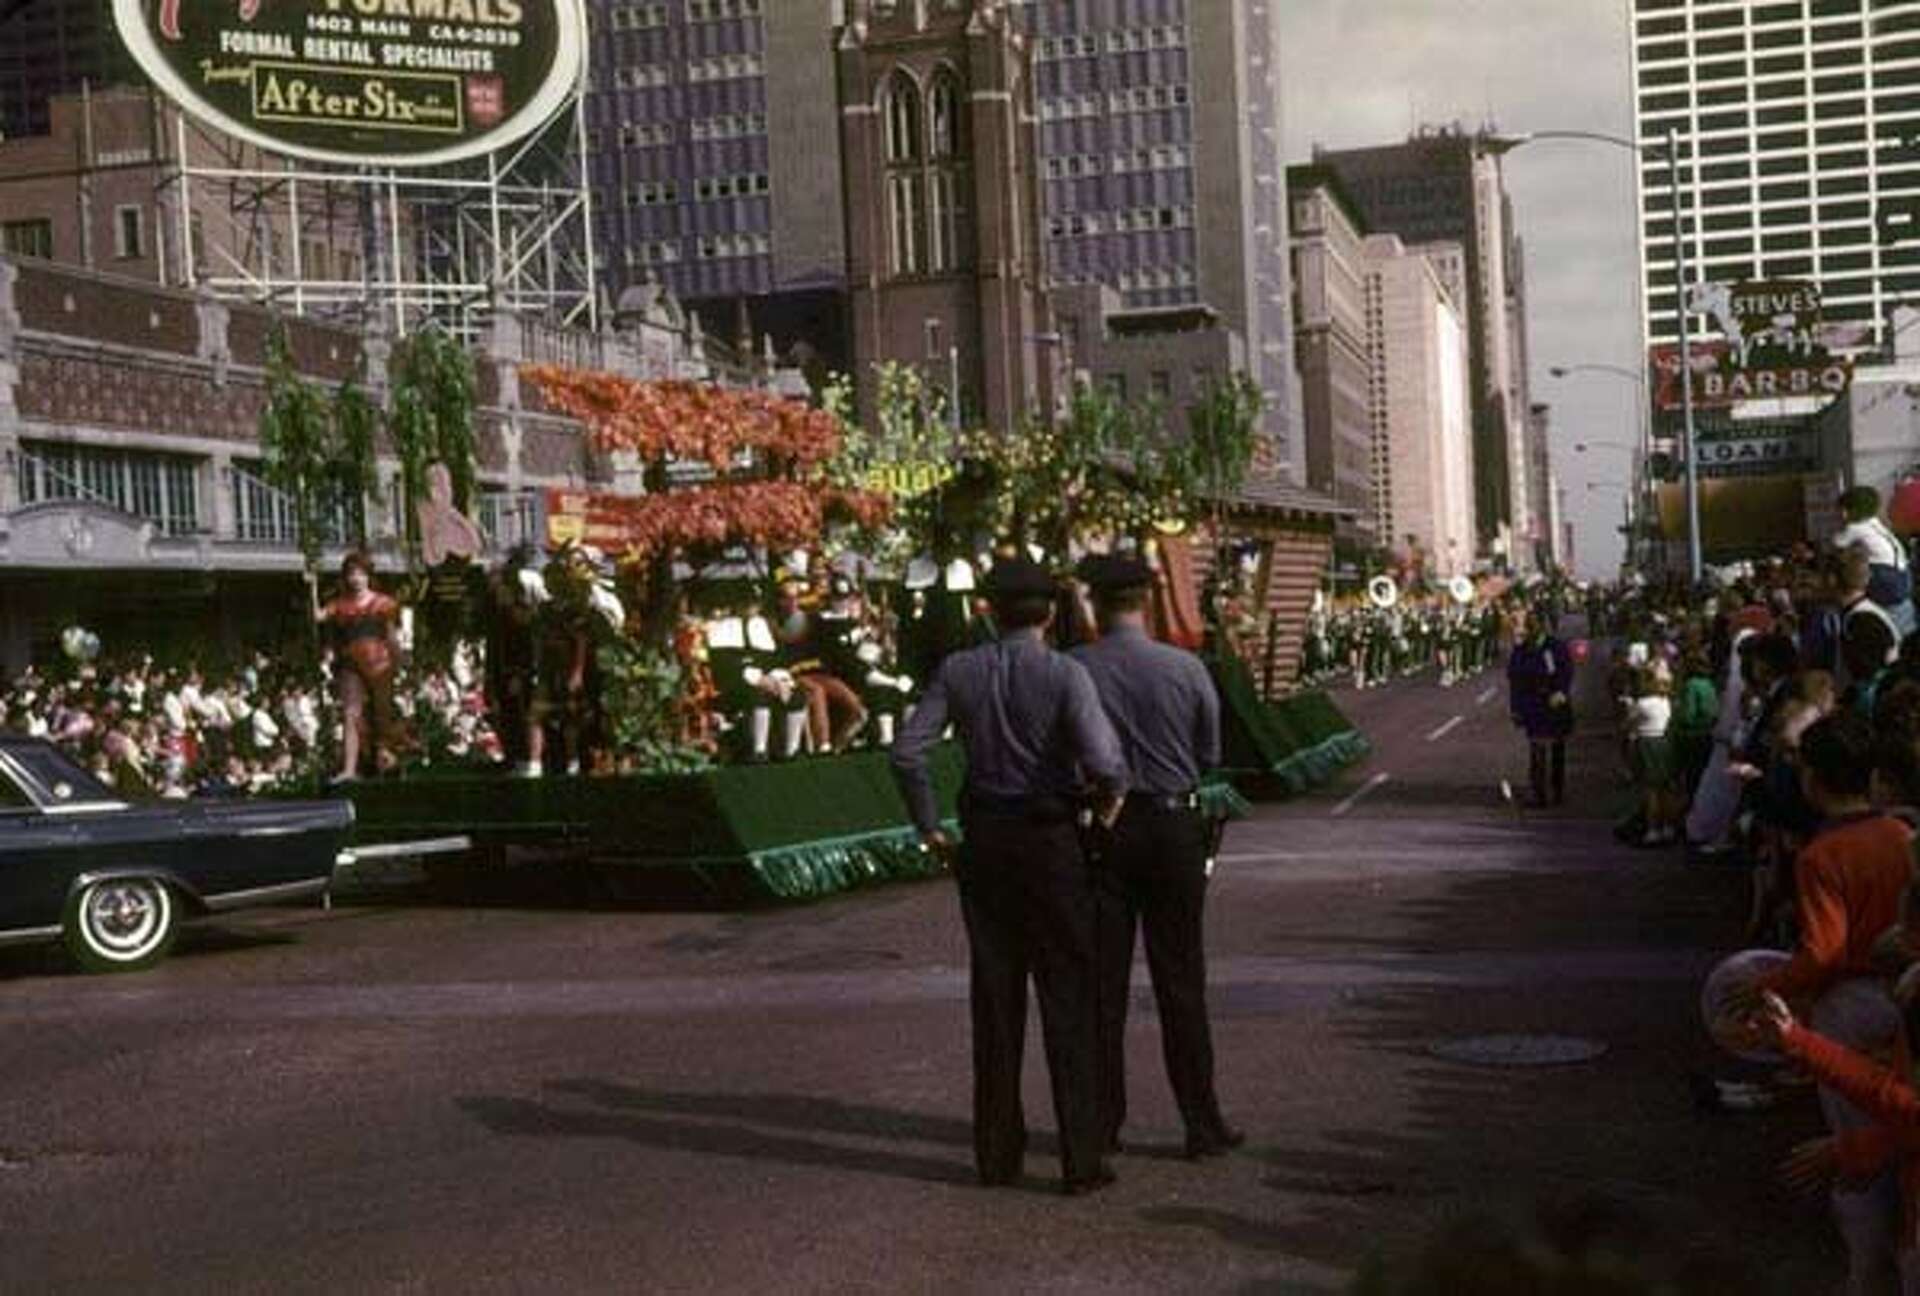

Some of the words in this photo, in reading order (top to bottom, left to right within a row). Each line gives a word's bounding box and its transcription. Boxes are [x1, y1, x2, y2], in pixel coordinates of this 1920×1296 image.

[327, 0, 522, 26] MALS
[360, 19, 411, 36] MAIN
[220, 30, 296, 57] FORMAL
[303, 37, 374, 64] RENTAL
[382, 43, 493, 71] SPECIALISTS
[260, 71, 359, 116] After
[363, 80, 415, 120] Six
